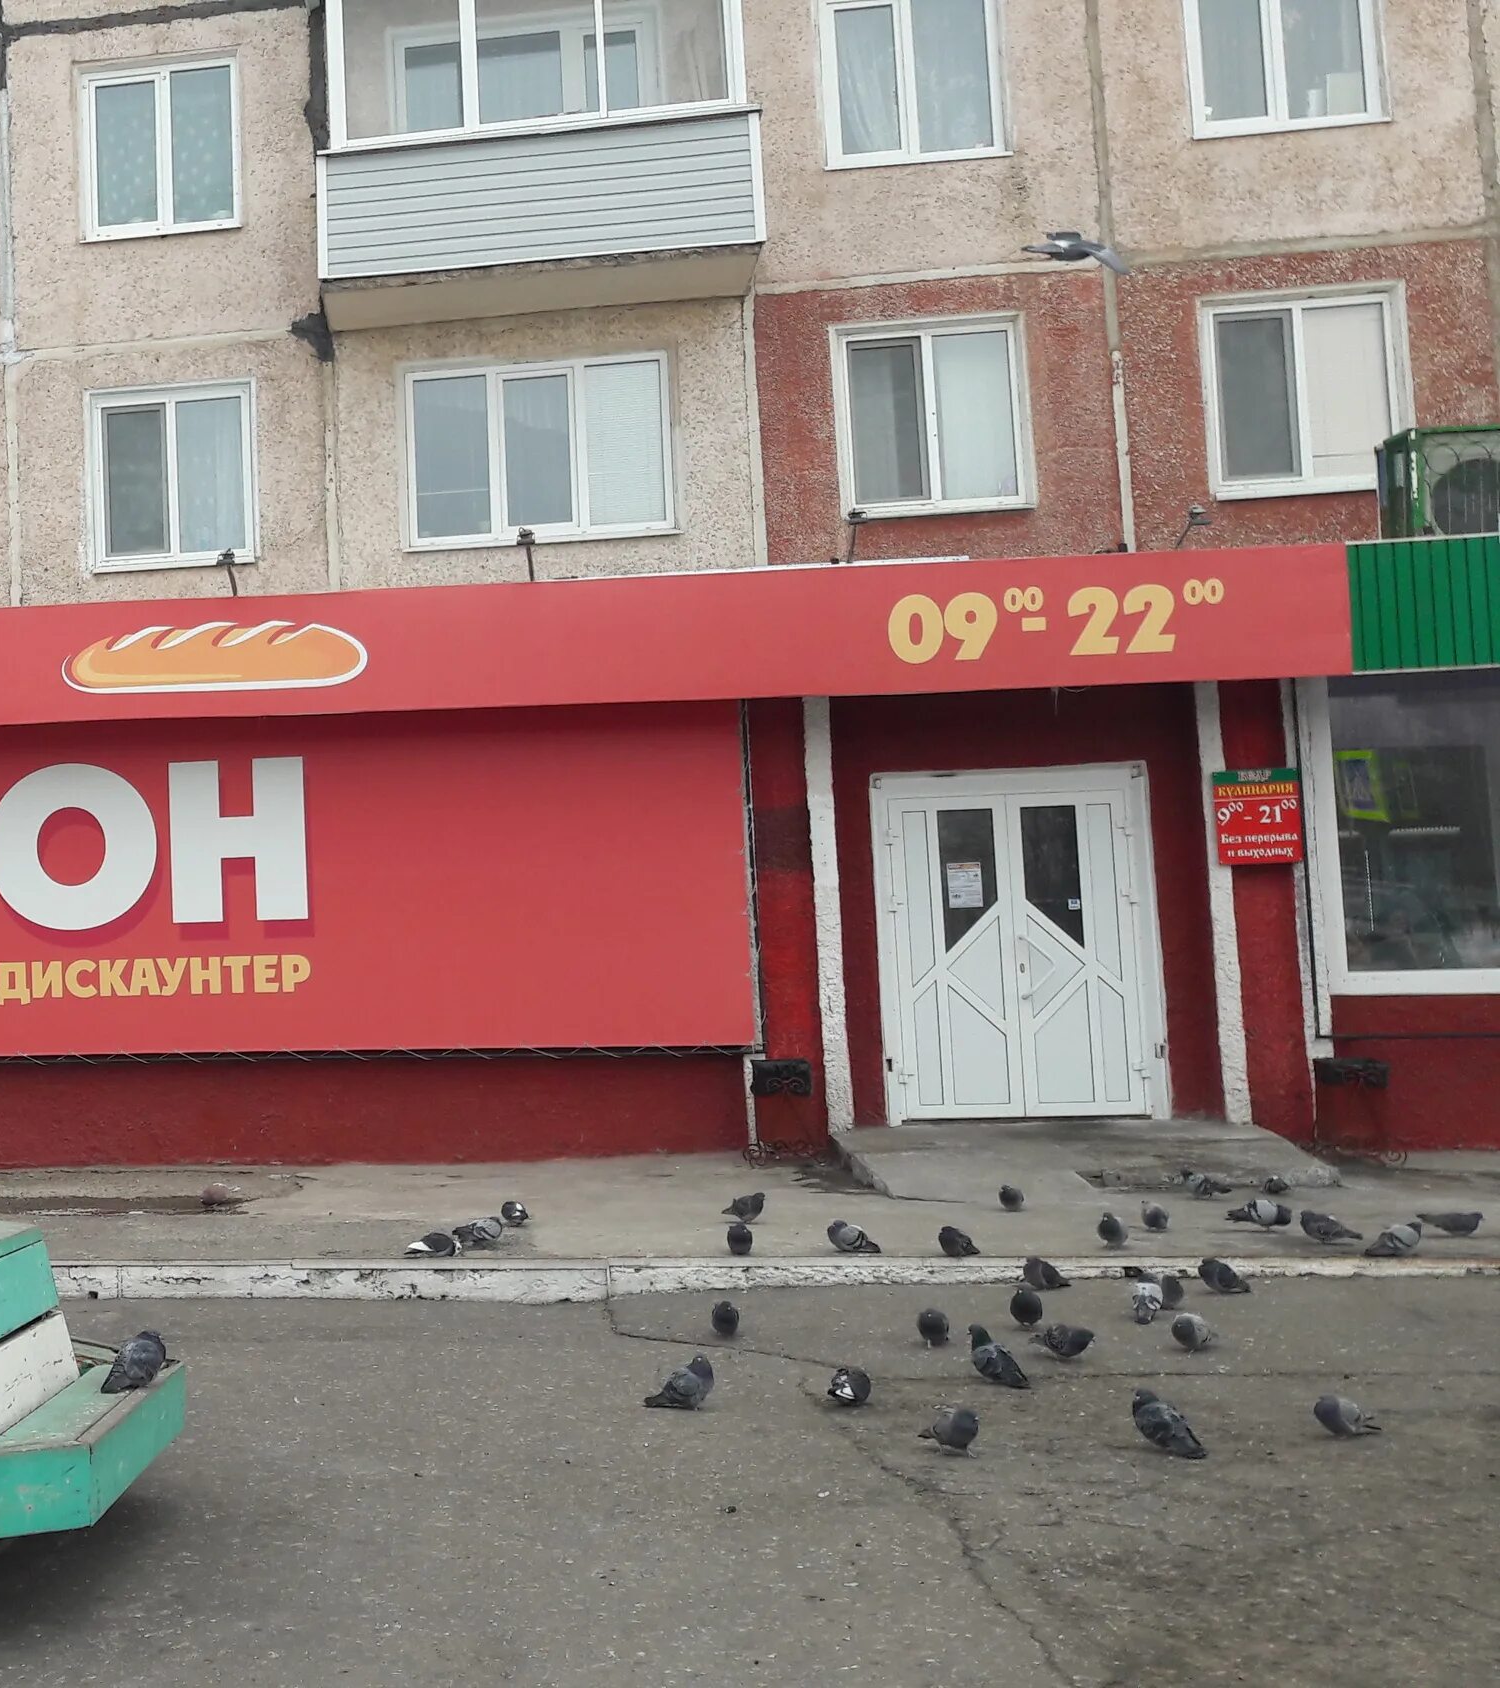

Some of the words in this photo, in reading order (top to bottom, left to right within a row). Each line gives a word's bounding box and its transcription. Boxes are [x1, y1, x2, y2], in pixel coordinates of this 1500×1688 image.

[1218, 783, 1294, 798] КУЛИНАРИЯ
[1221, 833, 1242, 844] Без
[1244, 832, 1298, 845] перерыва
[1227, 849, 1235, 857] и
[1237, 847, 1294, 859] выходных
